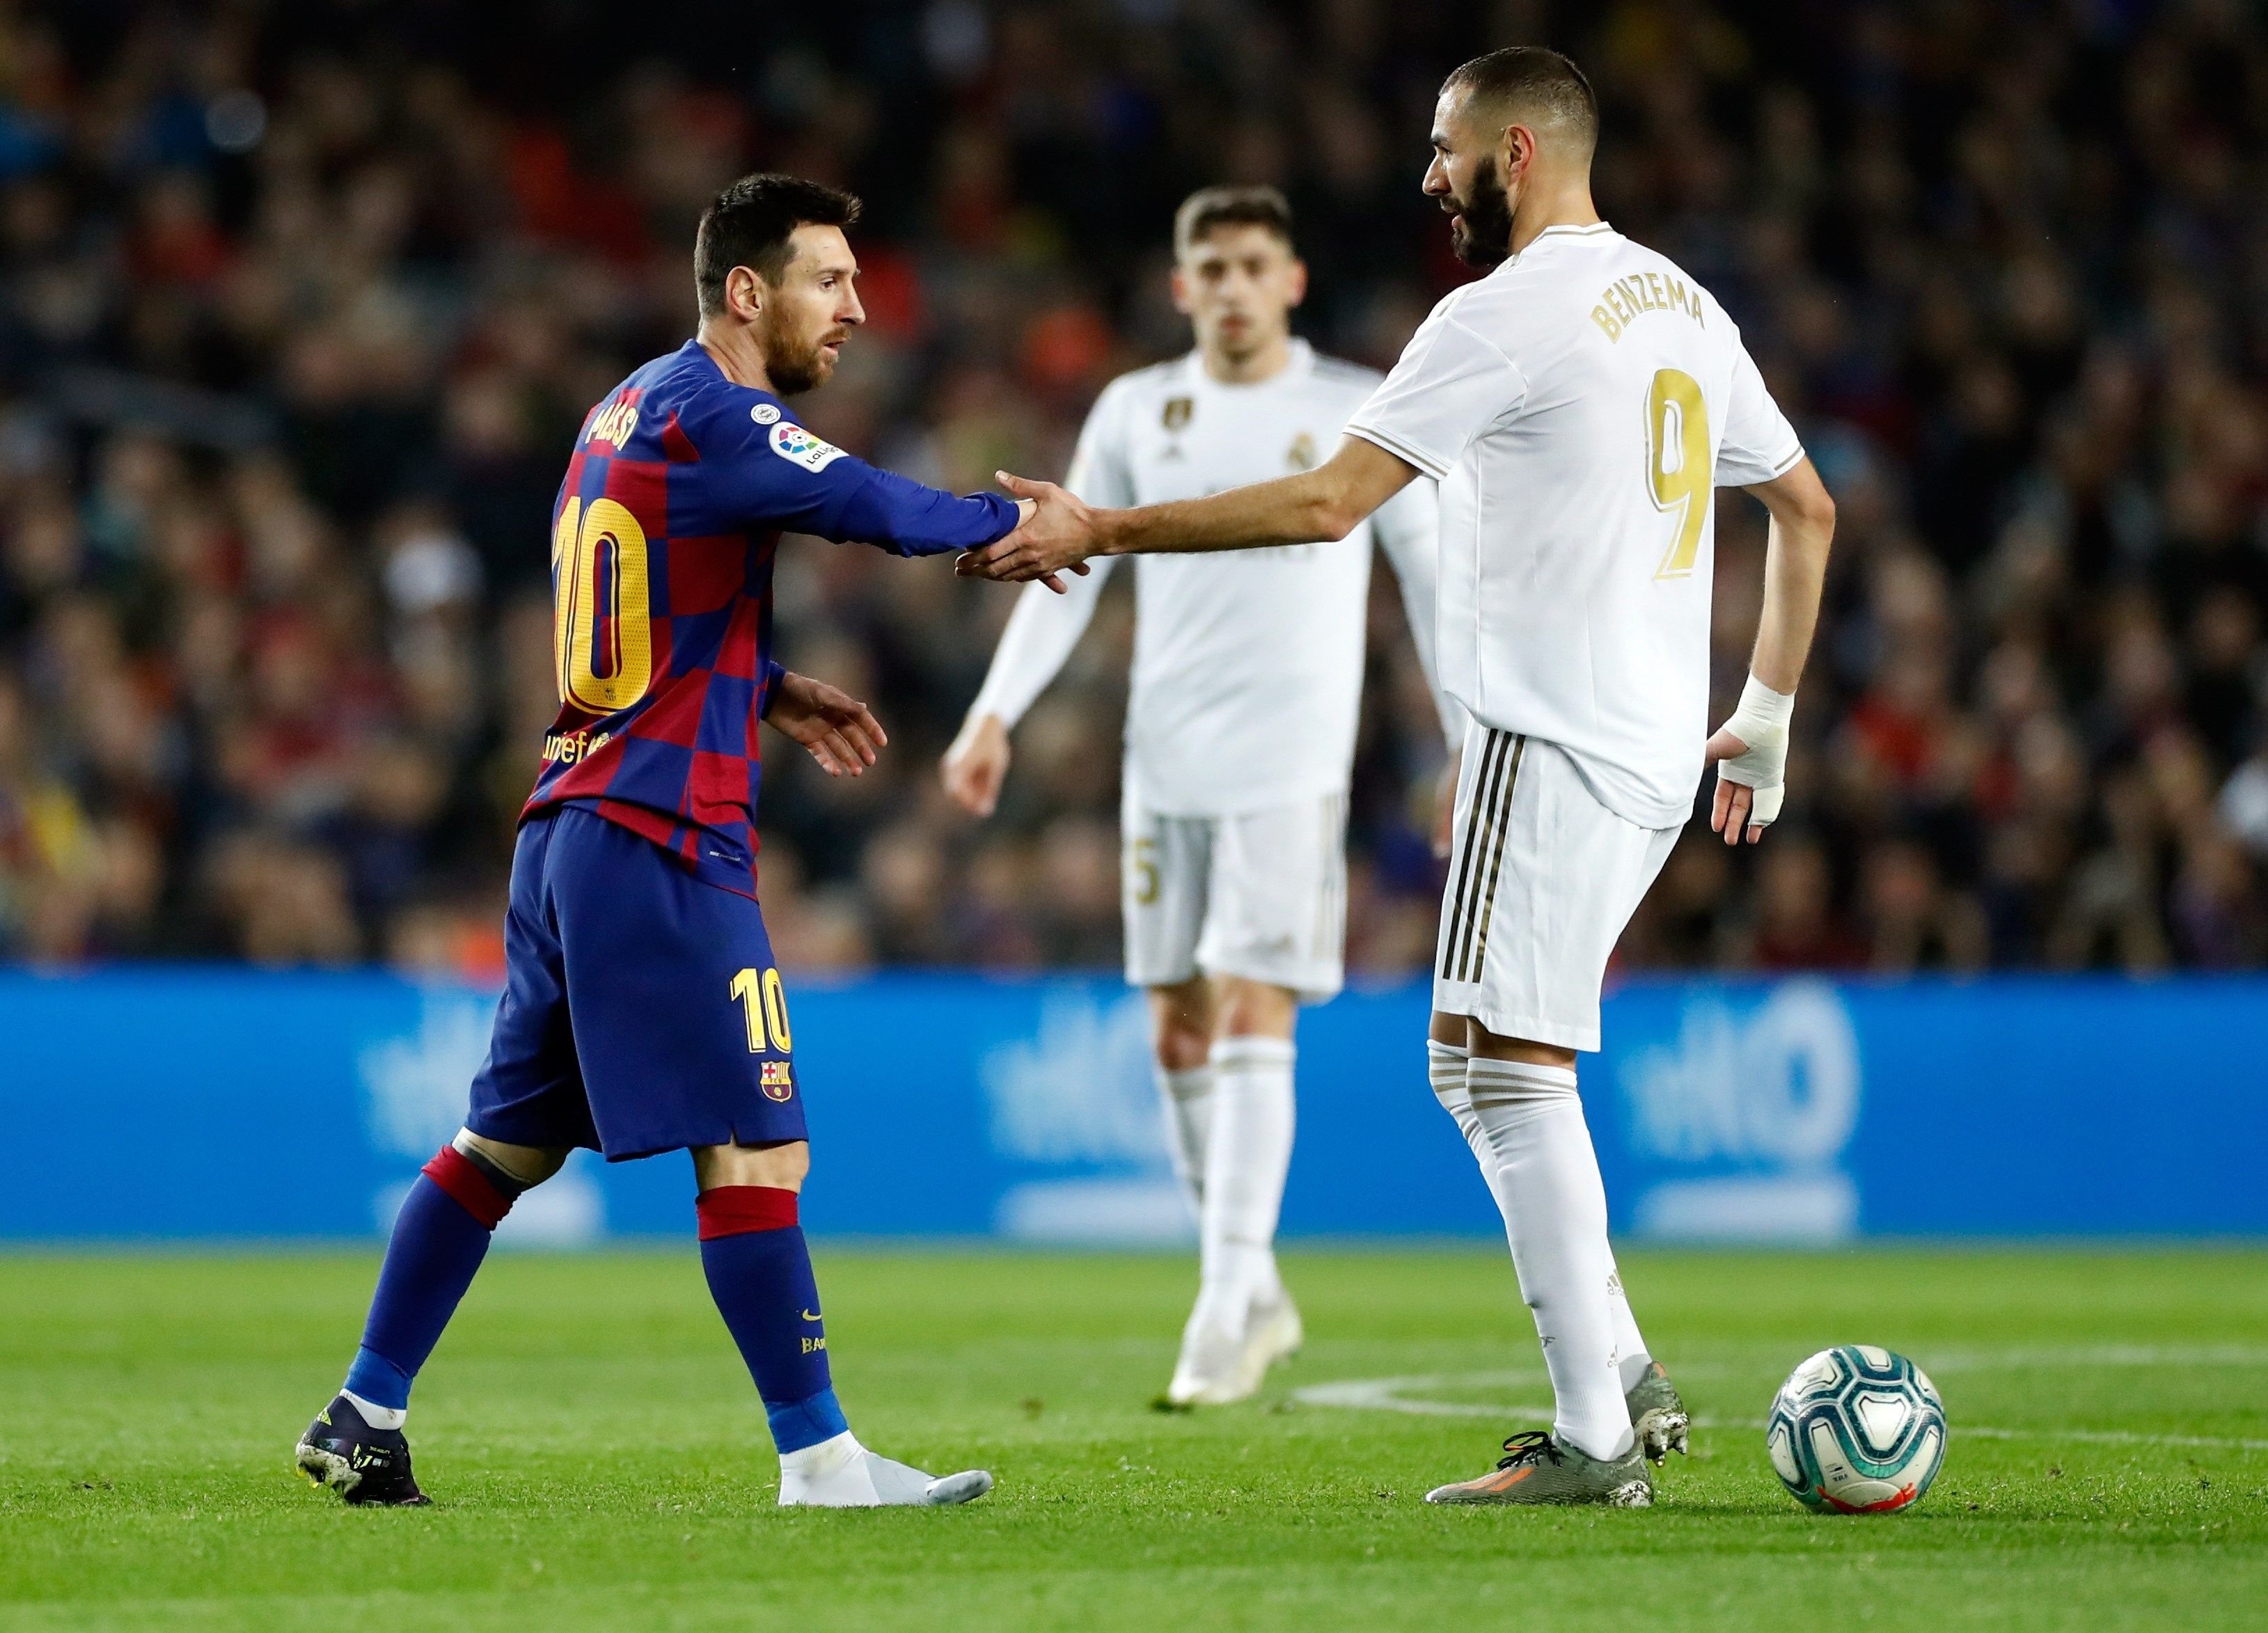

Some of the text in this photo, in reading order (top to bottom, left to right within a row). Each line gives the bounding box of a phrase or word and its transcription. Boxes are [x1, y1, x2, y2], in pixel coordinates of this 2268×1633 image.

[1590, 272, 1705, 344] BENZEMA
[1643, 368, 1712, 581] 9
[551, 496, 652, 716] 10
[730, 968, 792, 1054] 10
